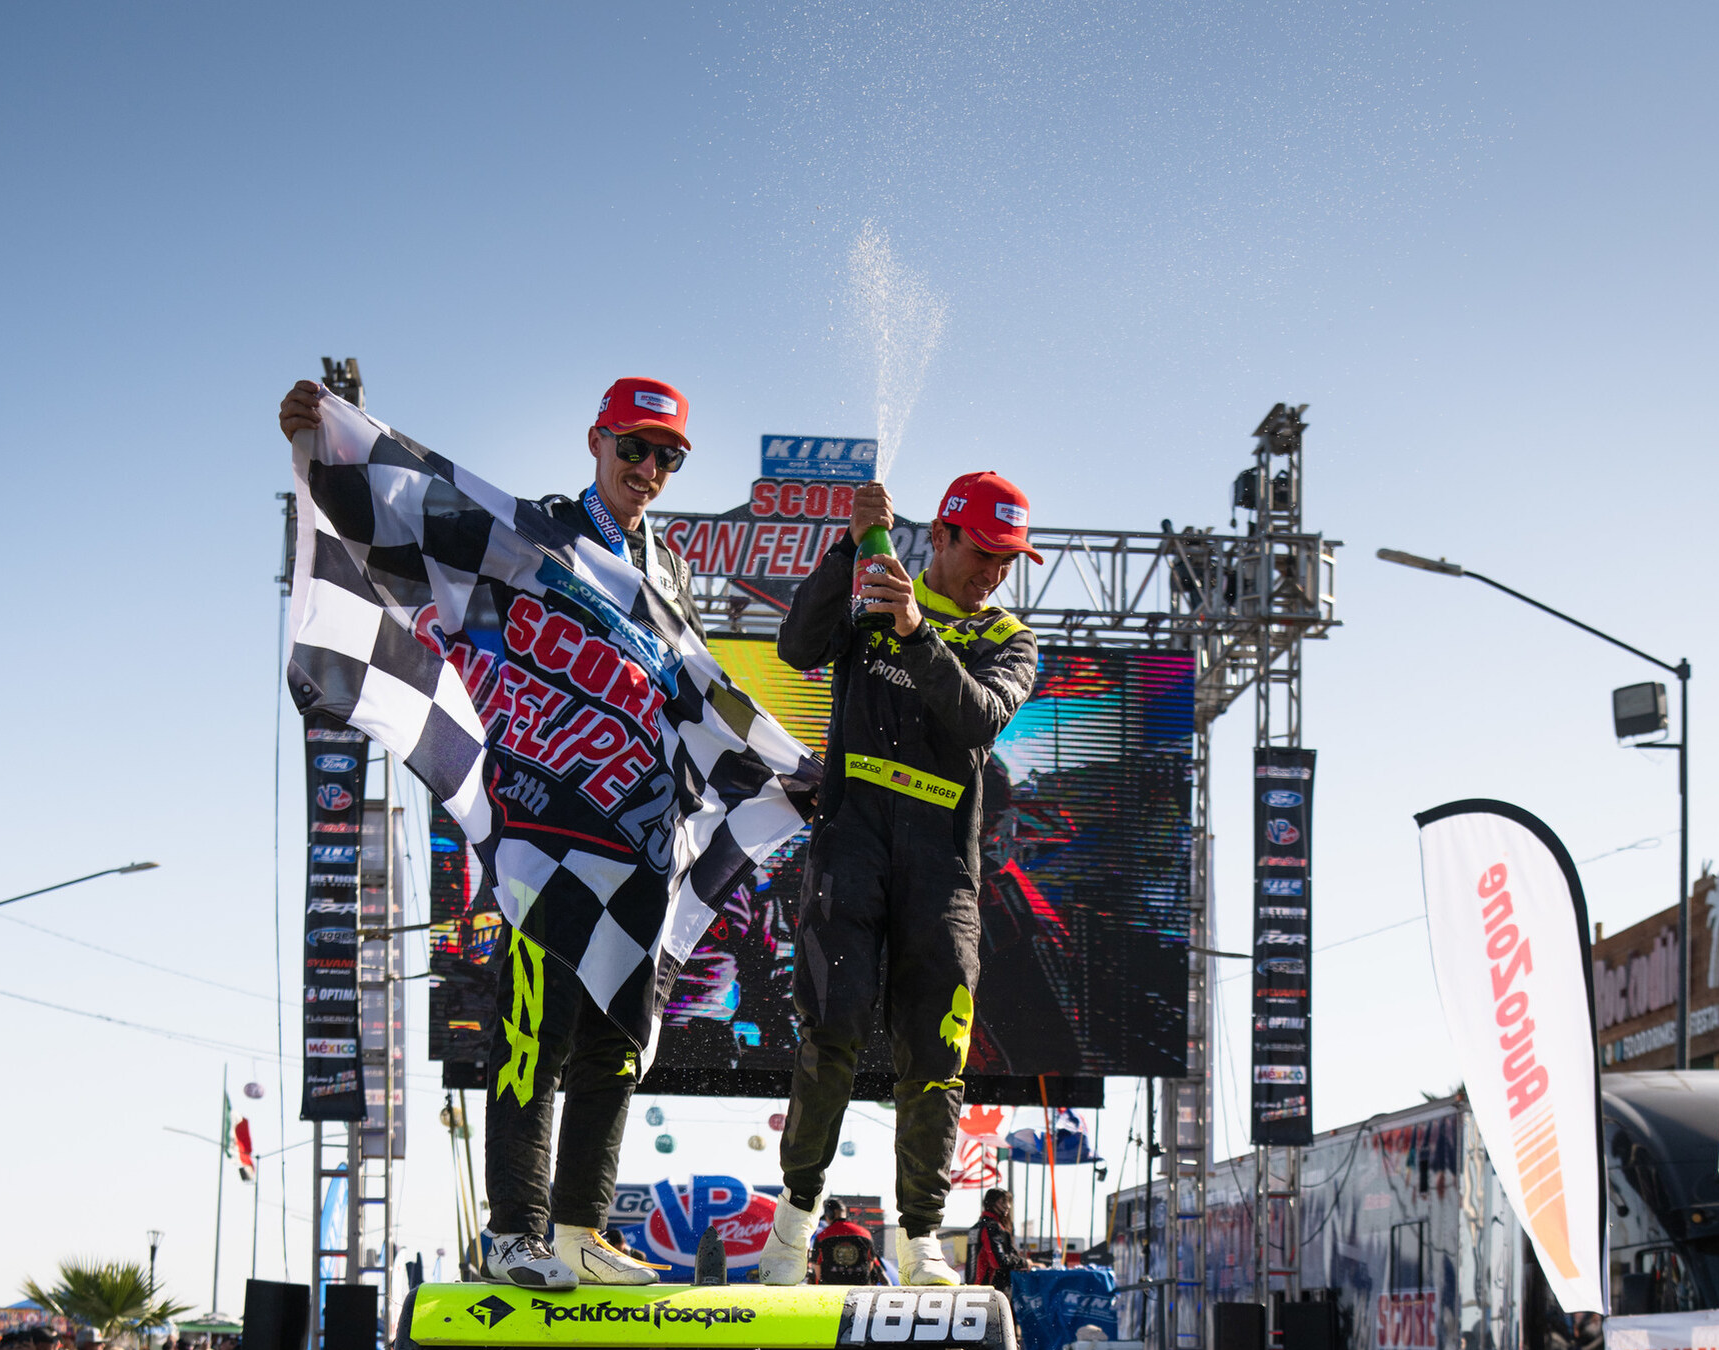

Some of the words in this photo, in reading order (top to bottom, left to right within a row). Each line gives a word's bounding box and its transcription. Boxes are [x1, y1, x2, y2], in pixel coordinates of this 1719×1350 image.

[766, 439, 877, 460] KING
[585, 494, 623, 544] FINISHER
[750, 482, 856, 518] SCOR
[942, 495, 967, 517] 1ST
[665, 519, 749, 577] SAN
[481, 660, 656, 812] FELIPE
[850, 760, 881, 774] sparco
[914, 779, 924, 790] B.
[926, 784, 957, 801] HEGER
[652, 1174, 749, 1254] VP
[531, 1297, 650, 1329] Rockford
[653, 1299, 756, 1330] Fosgate
[848, 1292, 990, 1342] 1896
[1378, 1292, 1436, 1347] SCORE
